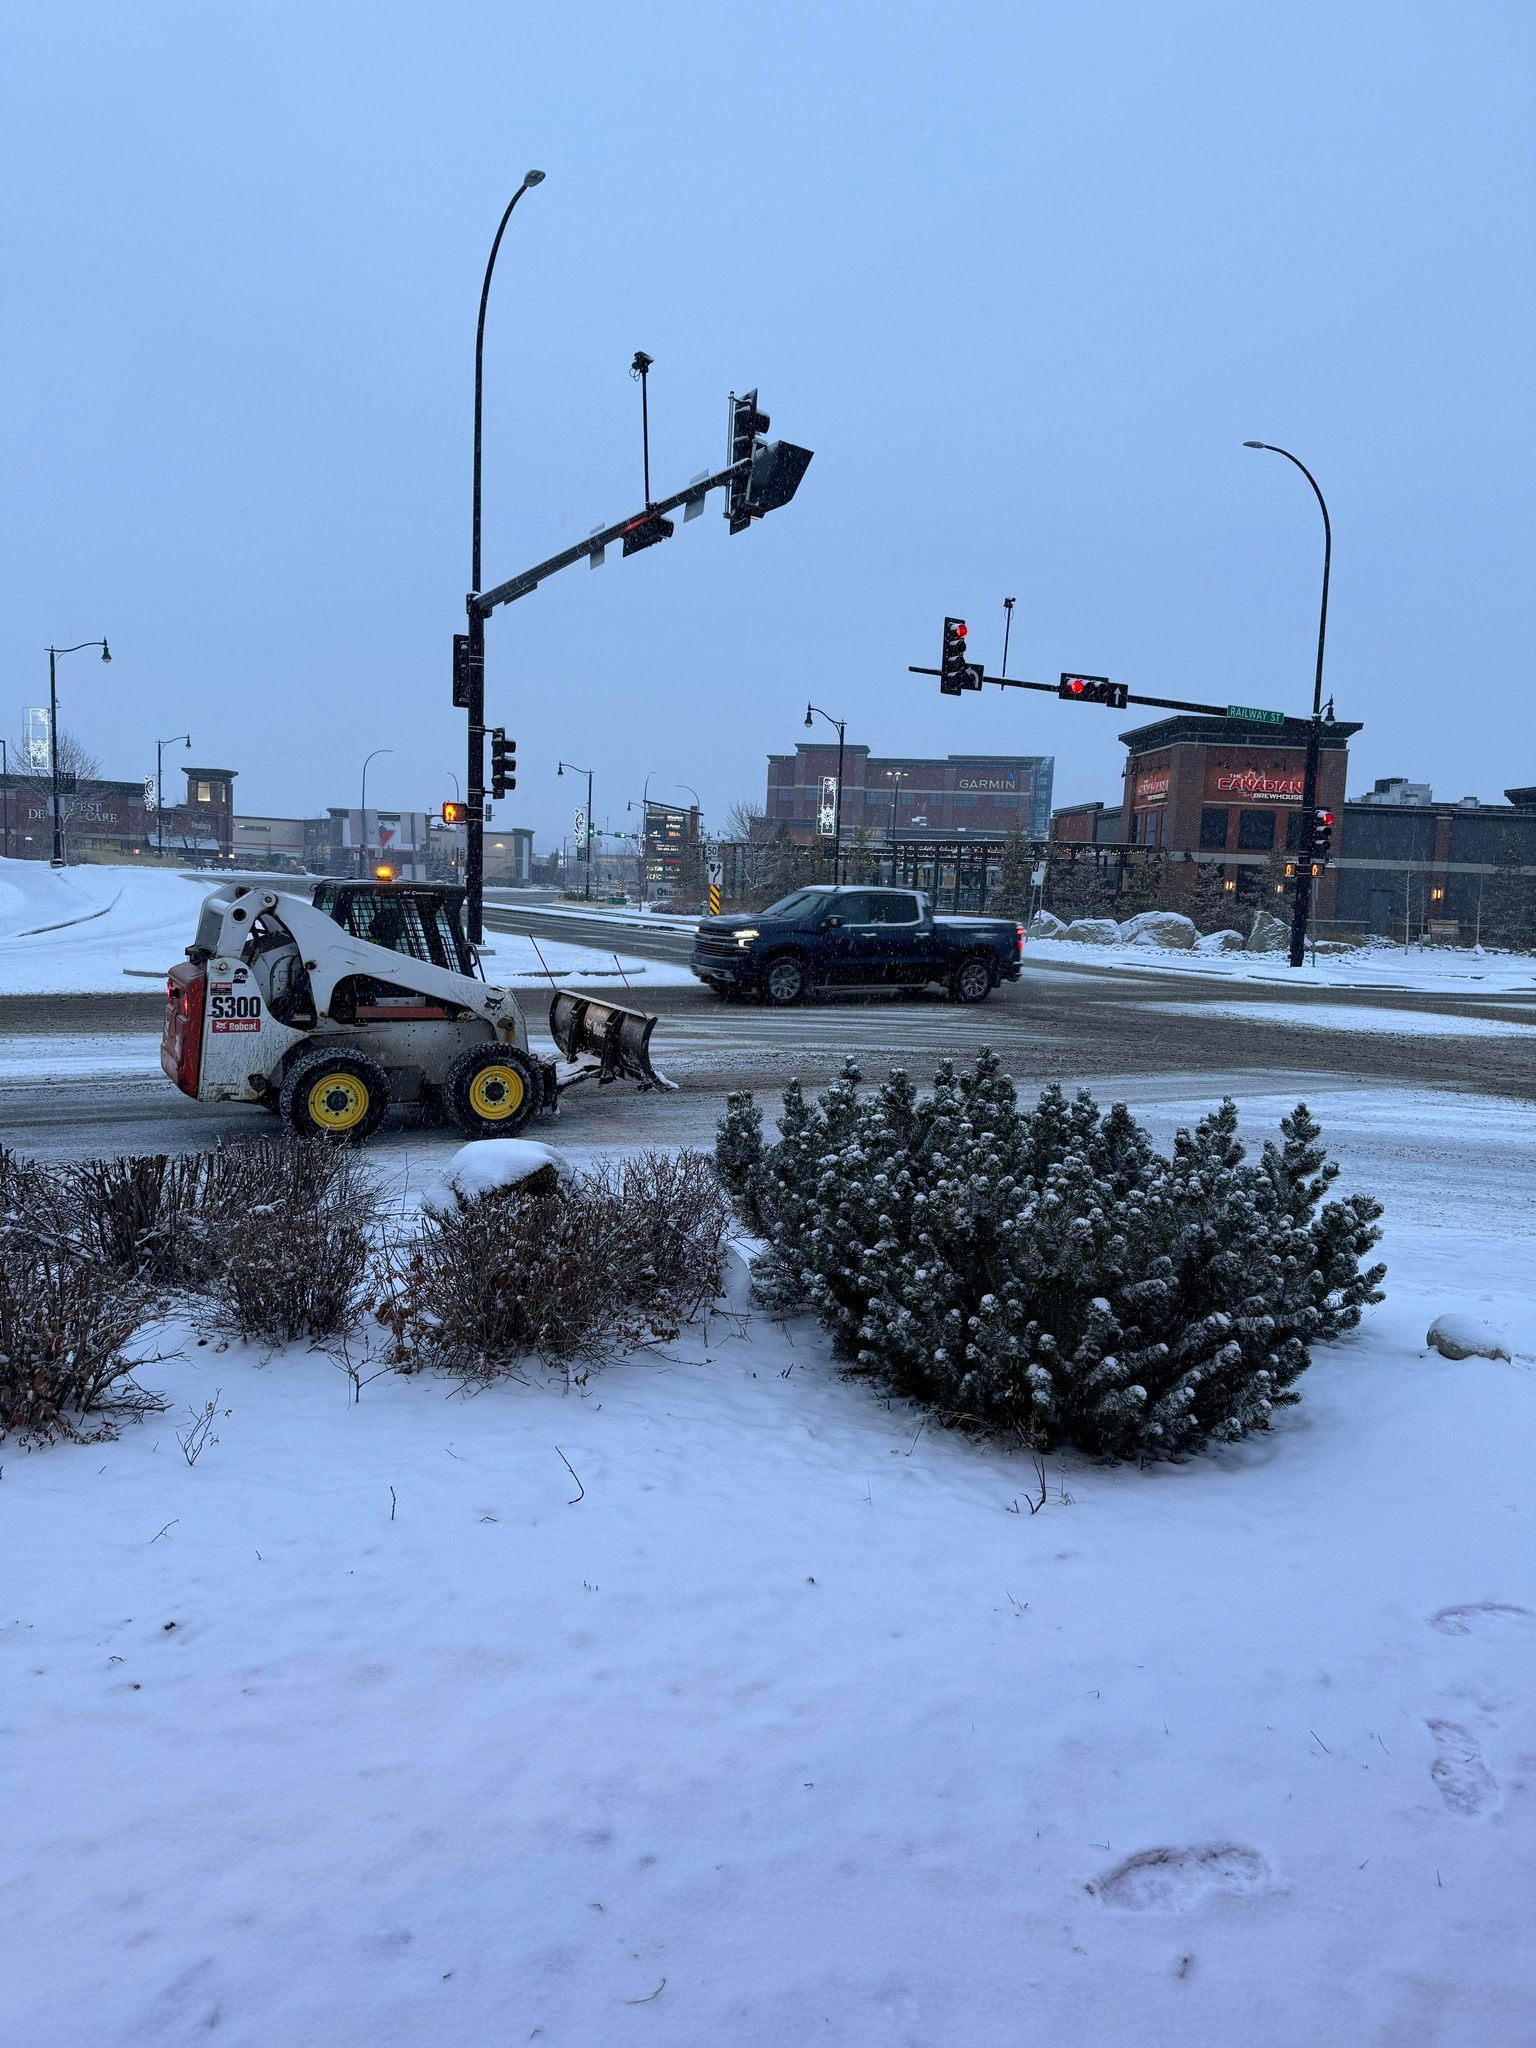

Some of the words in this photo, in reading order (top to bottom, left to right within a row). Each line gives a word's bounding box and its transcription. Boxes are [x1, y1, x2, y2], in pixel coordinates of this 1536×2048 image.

[1230, 706, 1268, 720] RAILWAY
[1270, 713, 1281, 722] ST
[960, 780, 1015, 789] GARMIN
[1218, 778, 1304, 793] CANADIAN
[86, 813, 117, 822] CARE
[707, 847, 717, 855] 50
[233, 968, 248, 983] 2
[212, 997, 261, 1018] S300
[229, 1022, 257, 1031] Bobcat
